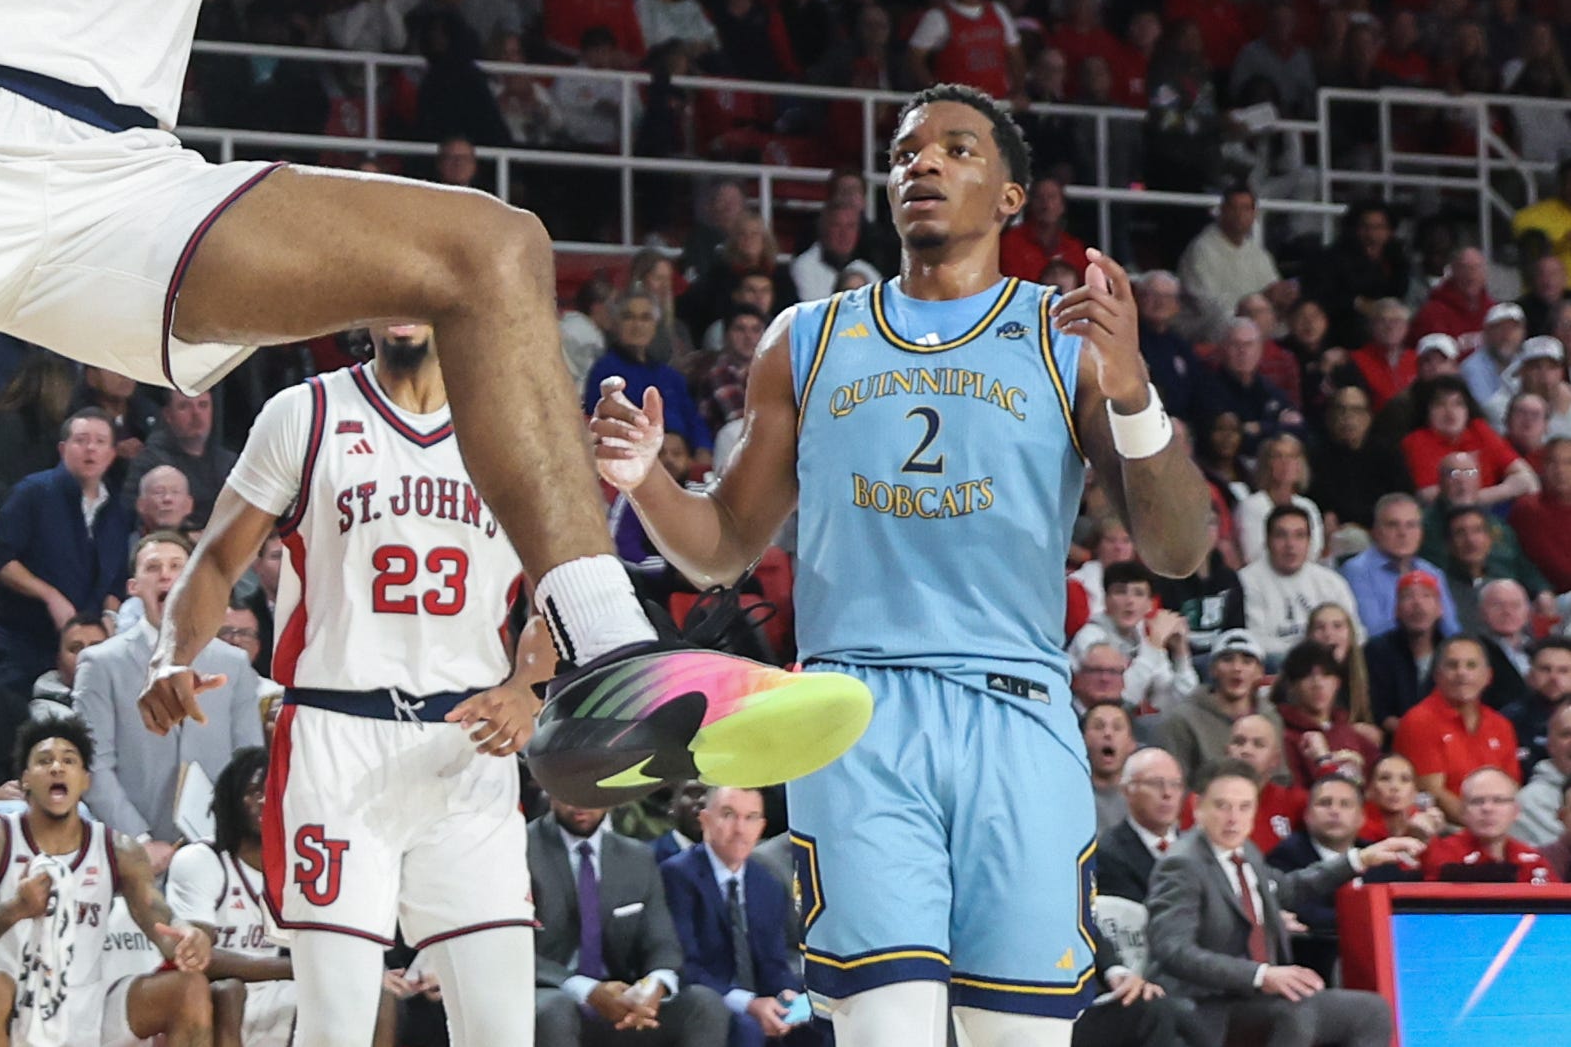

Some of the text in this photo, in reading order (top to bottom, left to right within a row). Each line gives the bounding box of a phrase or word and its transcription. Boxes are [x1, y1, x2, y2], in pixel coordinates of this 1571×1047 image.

[830, 368, 1027, 421] QUINNIPIAC
[901, 406, 944, 474] 2
[337, 480, 382, 536] ST.
[852, 472, 995, 520] BOBCATS
[372, 544, 469, 616] 23
[294, 823, 350, 906] SJ
